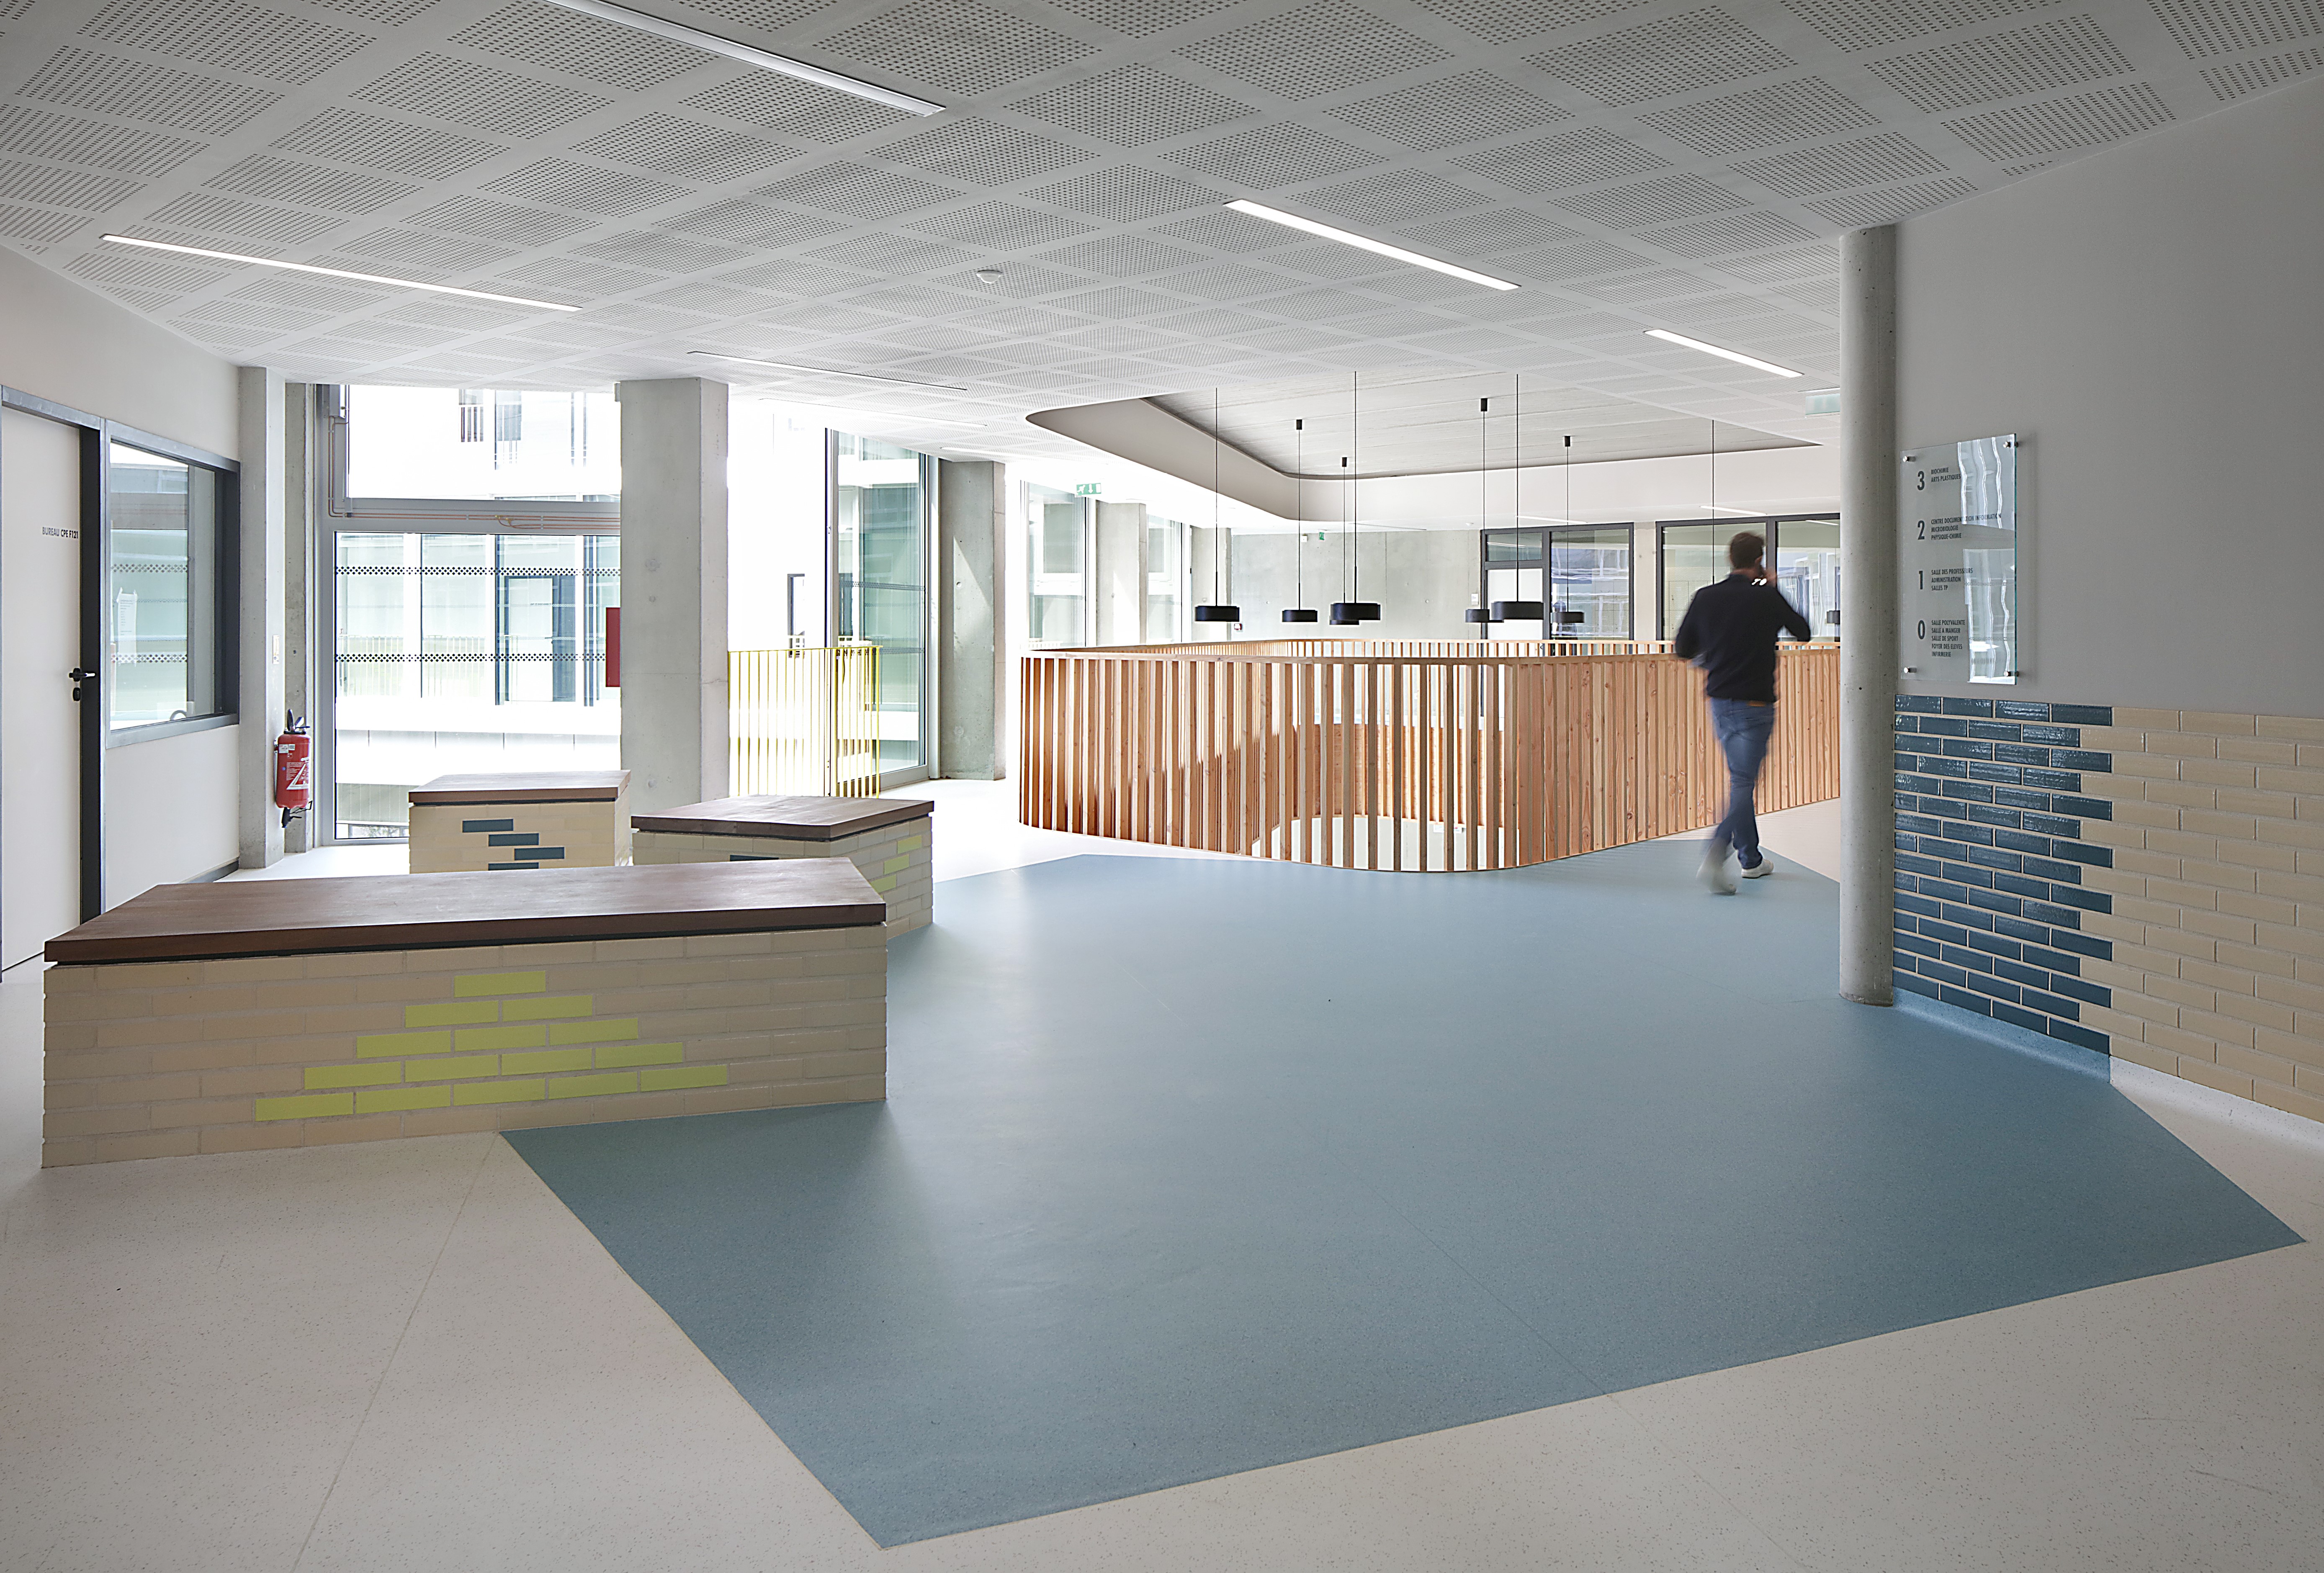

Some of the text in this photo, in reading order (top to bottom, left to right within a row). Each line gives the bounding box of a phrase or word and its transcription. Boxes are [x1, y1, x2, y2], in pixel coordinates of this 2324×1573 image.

[1917, 471, 1925, 491] 3
[1944, 515, 1974, 524] DOCUMENTTION
[42, 527, 59, 536] BUREAU
[69, 530, 78, 539] F121
[1917, 520, 1925, 540] 2
[1918, 571, 1923, 590] 1
[1917, 620, 1925, 640] 0
